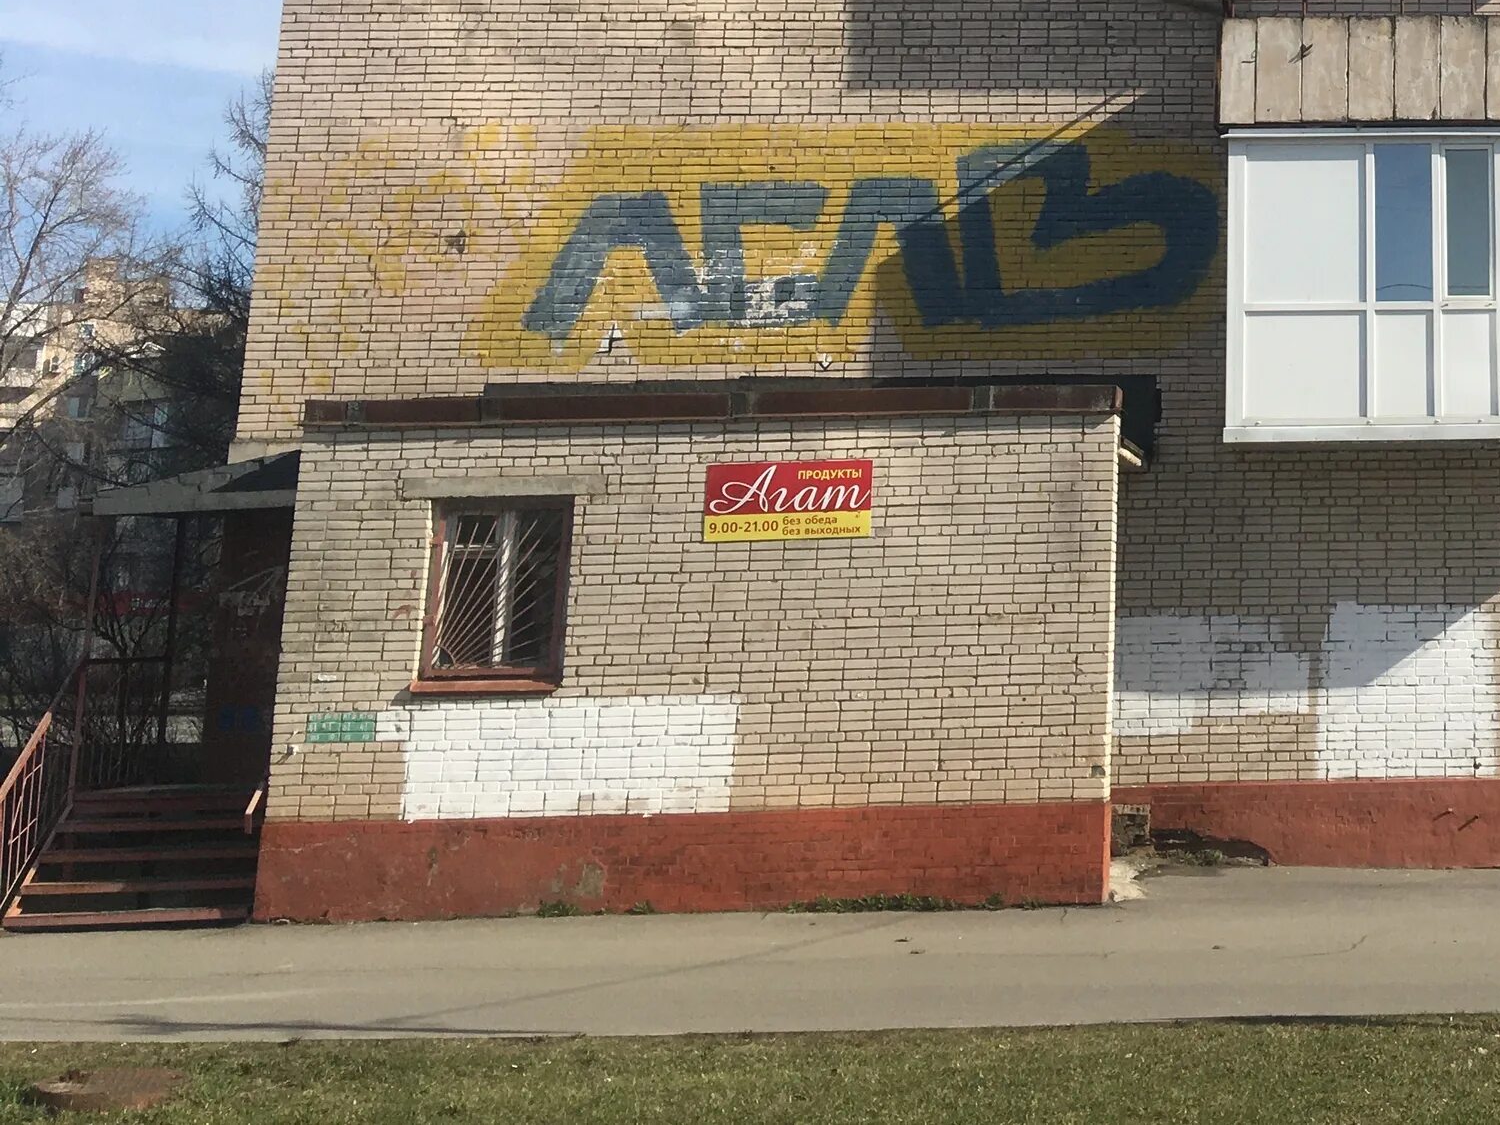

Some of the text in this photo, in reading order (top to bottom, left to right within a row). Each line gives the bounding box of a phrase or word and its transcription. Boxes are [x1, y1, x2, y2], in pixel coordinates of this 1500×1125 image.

[797, 468, 862, 481] ПРОДУКТЫ
[709, 464, 871, 513] Агат
[782, 515, 838, 525] без обеда
[709, 520, 779, 534] 9.00-21.00
[782, 525, 861, 536] без выходных
